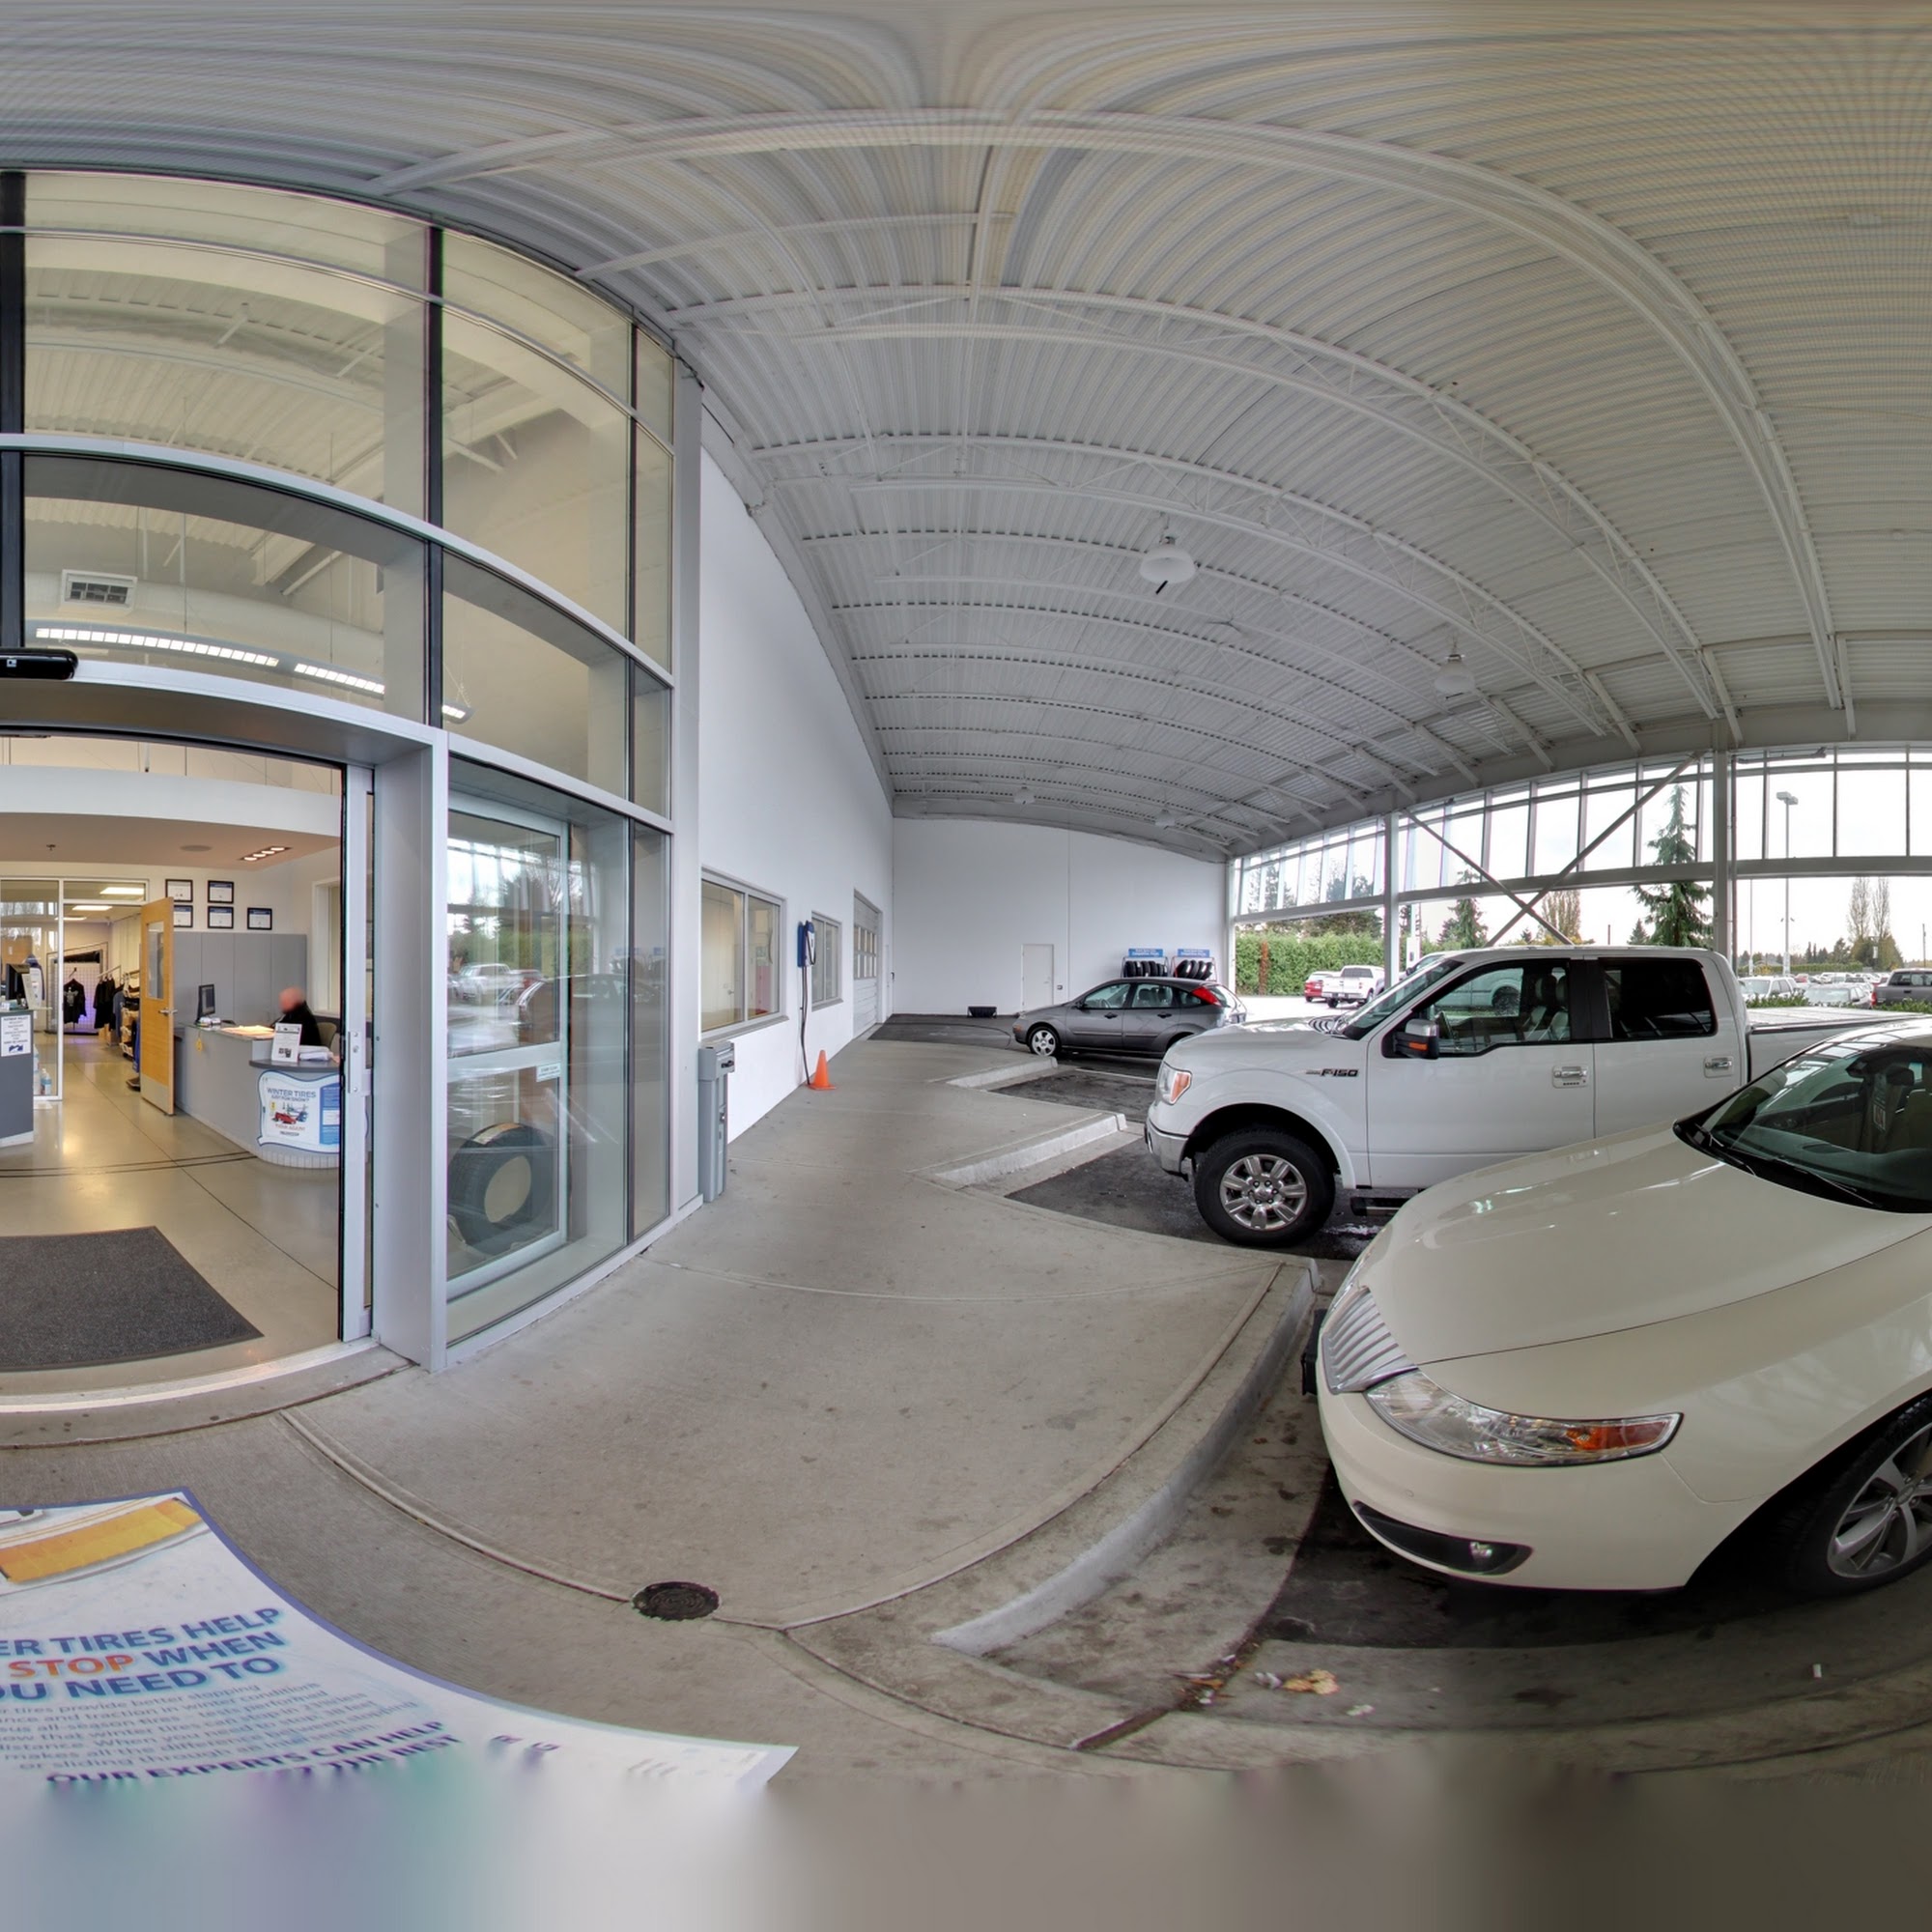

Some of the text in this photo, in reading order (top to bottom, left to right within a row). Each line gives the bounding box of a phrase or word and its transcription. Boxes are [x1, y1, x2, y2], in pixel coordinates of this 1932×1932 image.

[267, 1088, 293, 1096] WINTER
[294, 1090, 316, 1098] TIRES
[49, 1627, 175, 1653] TIRES
[181, 1607, 280, 1639] HELP
[9, 1631, 286, 1678] STOP WHEN
[65, 1669, 207, 1697] NEED
[210, 1658, 280, 1679] TO
[44, 1713, 79, 1721] and
[85, 1709, 157, 1719] traction
[183, 1697, 236, 1710] winter
[59, 1701, 128, 1715] provide
[131, 1695, 183, 1707] better
[187, 1684, 261, 1699] stopping
[198, 1706, 241, 1718] tests
[242, 1690, 328, 1713] performed
[5, 1701, 418, 1760] makes all the difference between stopping
[88, 1727, 153, 1738] winter
[157, 1723, 201, 1732] tires
[204, 1717, 238, 1726] can
[239, 1711, 280, 1721] stop
[94, 1737, 157, 1747] When
[161, 1732, 200, 1743] you
[204, 1723, 253, 1737] need
[255, 1720, 276, 1729] to
[52, 1758, 133, 1770] sliding
[138, 1747, 232, 1762] through
[236, 1744, 263, 1753] an
[146, 1752, 308, 1777] EXPERTS
[309, 1739, 380, 1757] CAN
[375, 1721, 443, 1743] HELP
